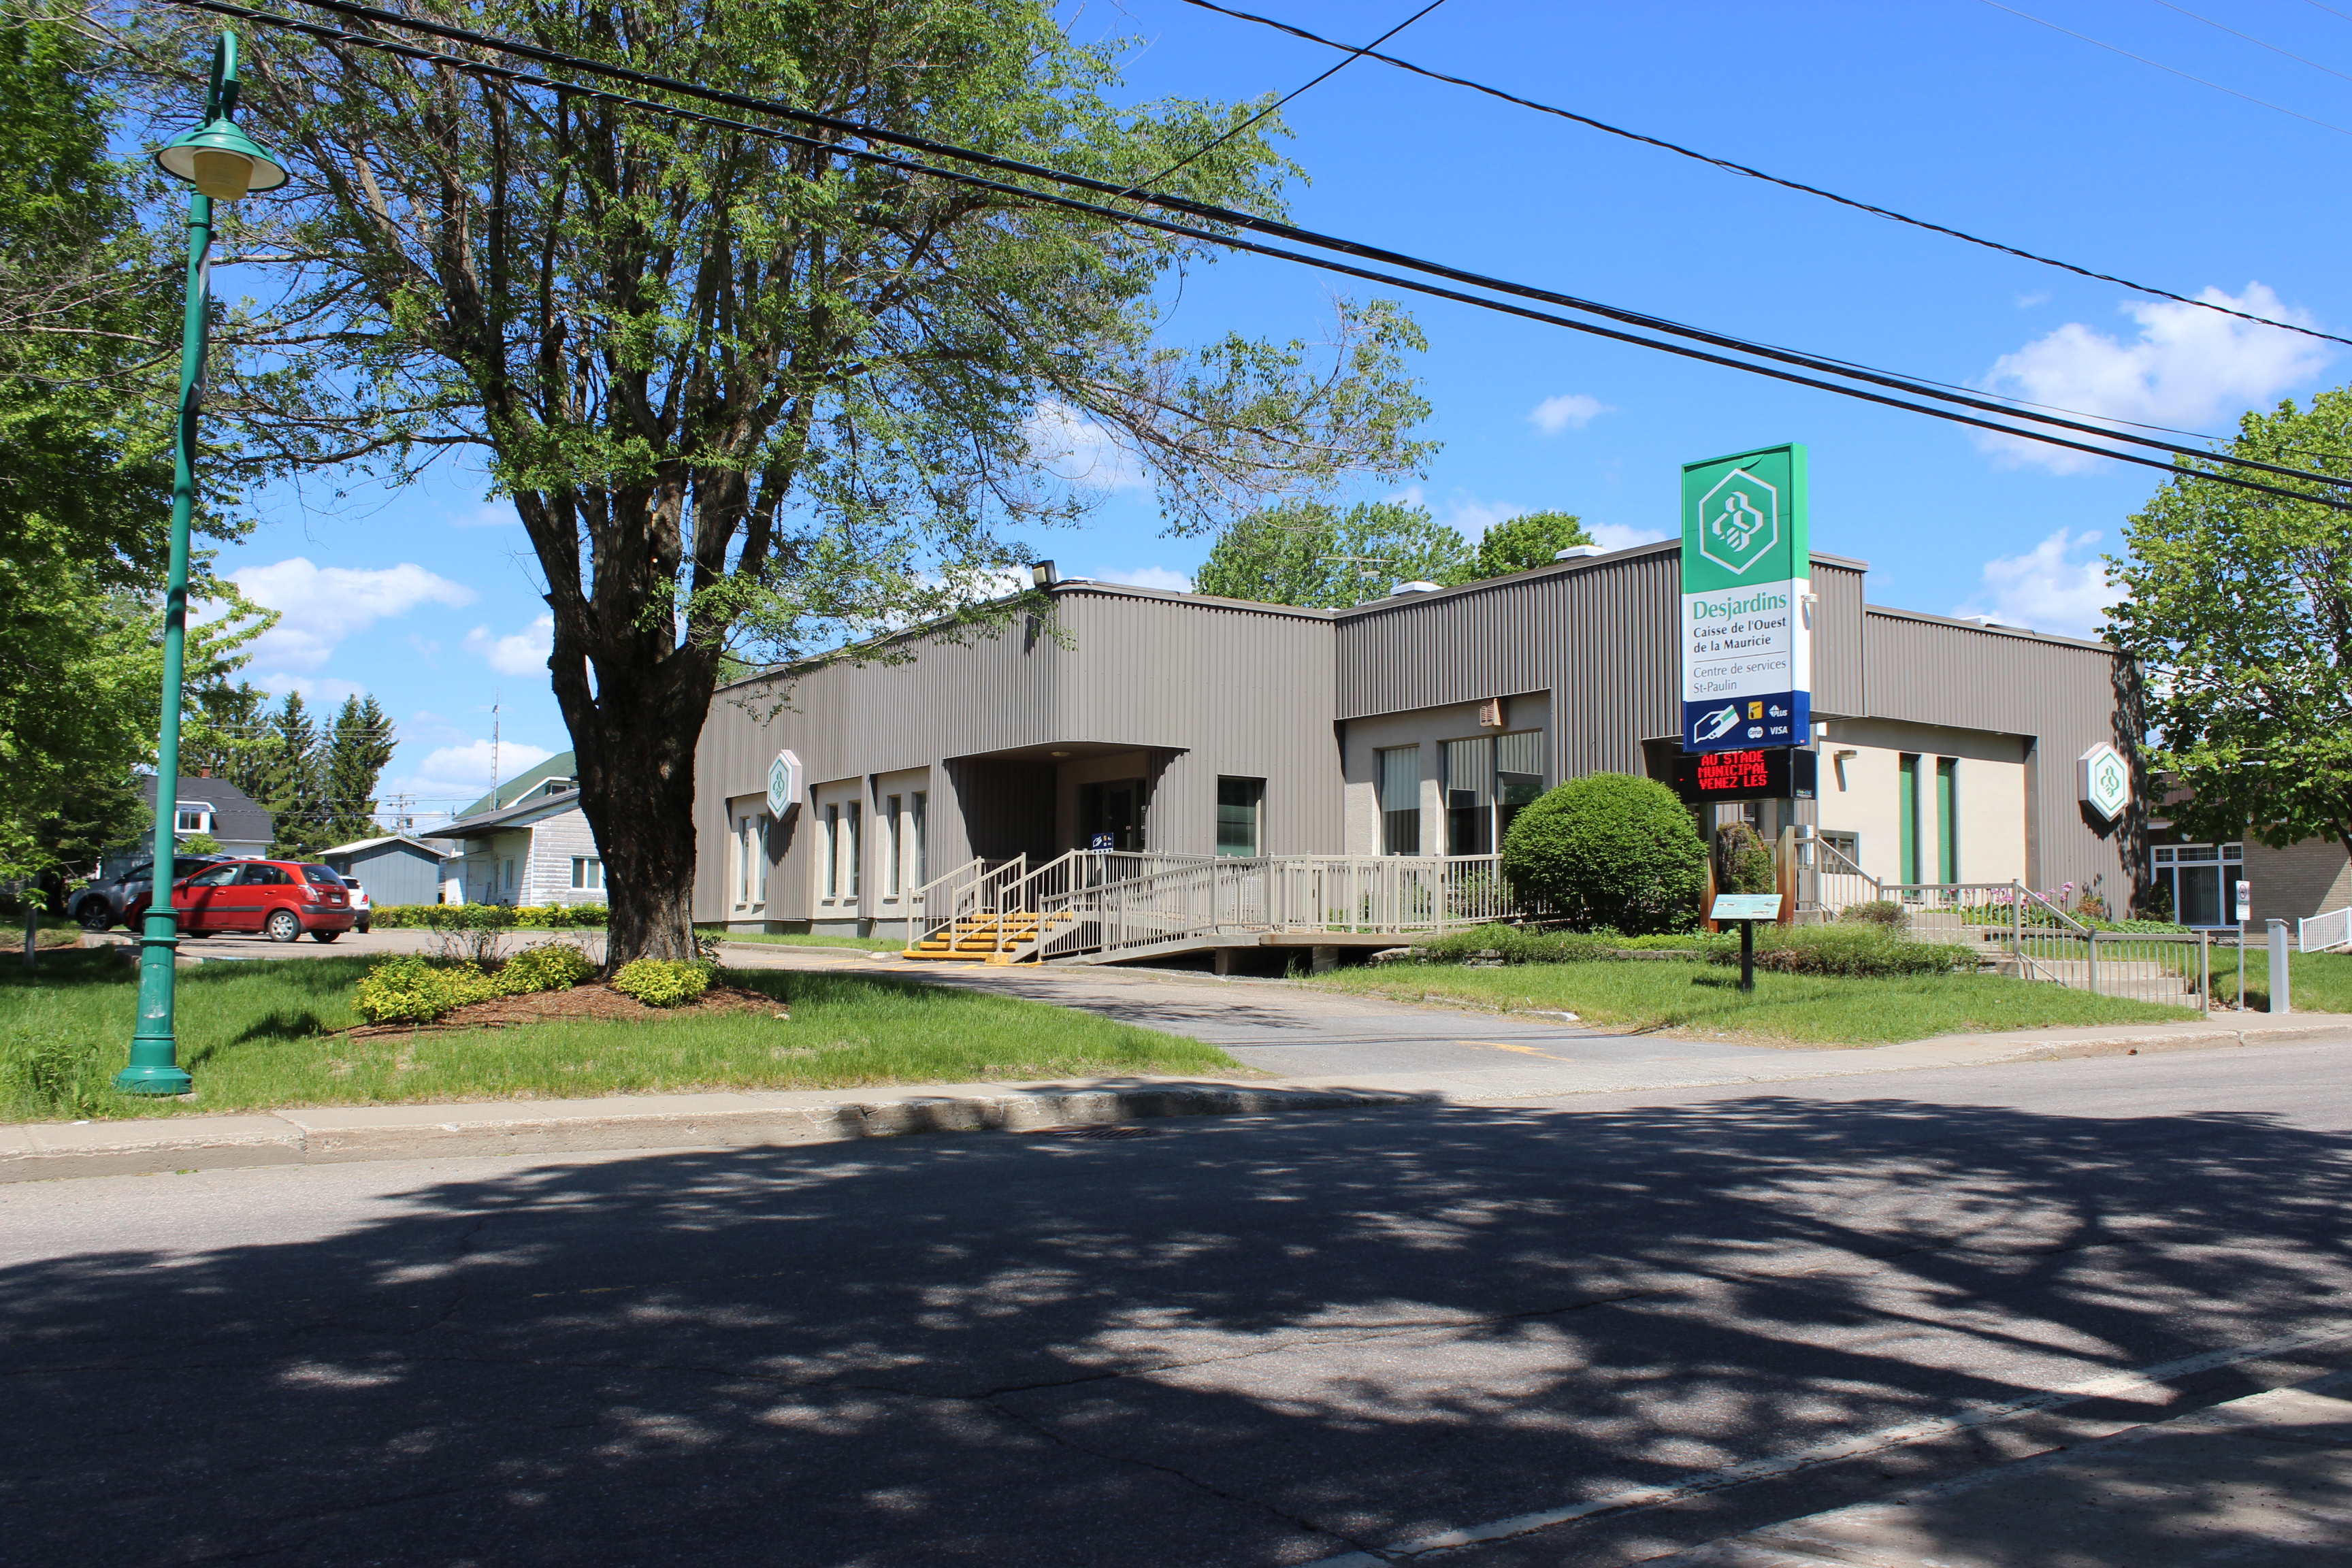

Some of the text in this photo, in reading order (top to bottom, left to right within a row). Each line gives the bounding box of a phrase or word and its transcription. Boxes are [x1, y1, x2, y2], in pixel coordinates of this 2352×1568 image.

[1693, 591, 1787, 621] Desjardins
[1693, 617, 1786, 638] Caisse de l'Ouest
[1694, 634, 1771, 653] de la Mauricie
[1693, 659, 1786, 678] Centre de services
[1693, 679, 1737, 693] St-Paulin
[1773, 709, 1788, 717] PLUS
[1769, 725, 1788, 735] VISA
[1701, 750, 1765, 766] AU STADE
[1698, 762, 1768, 779] MUNICIPAL
[1699, 774, 1767, 790] VENEZ LES
